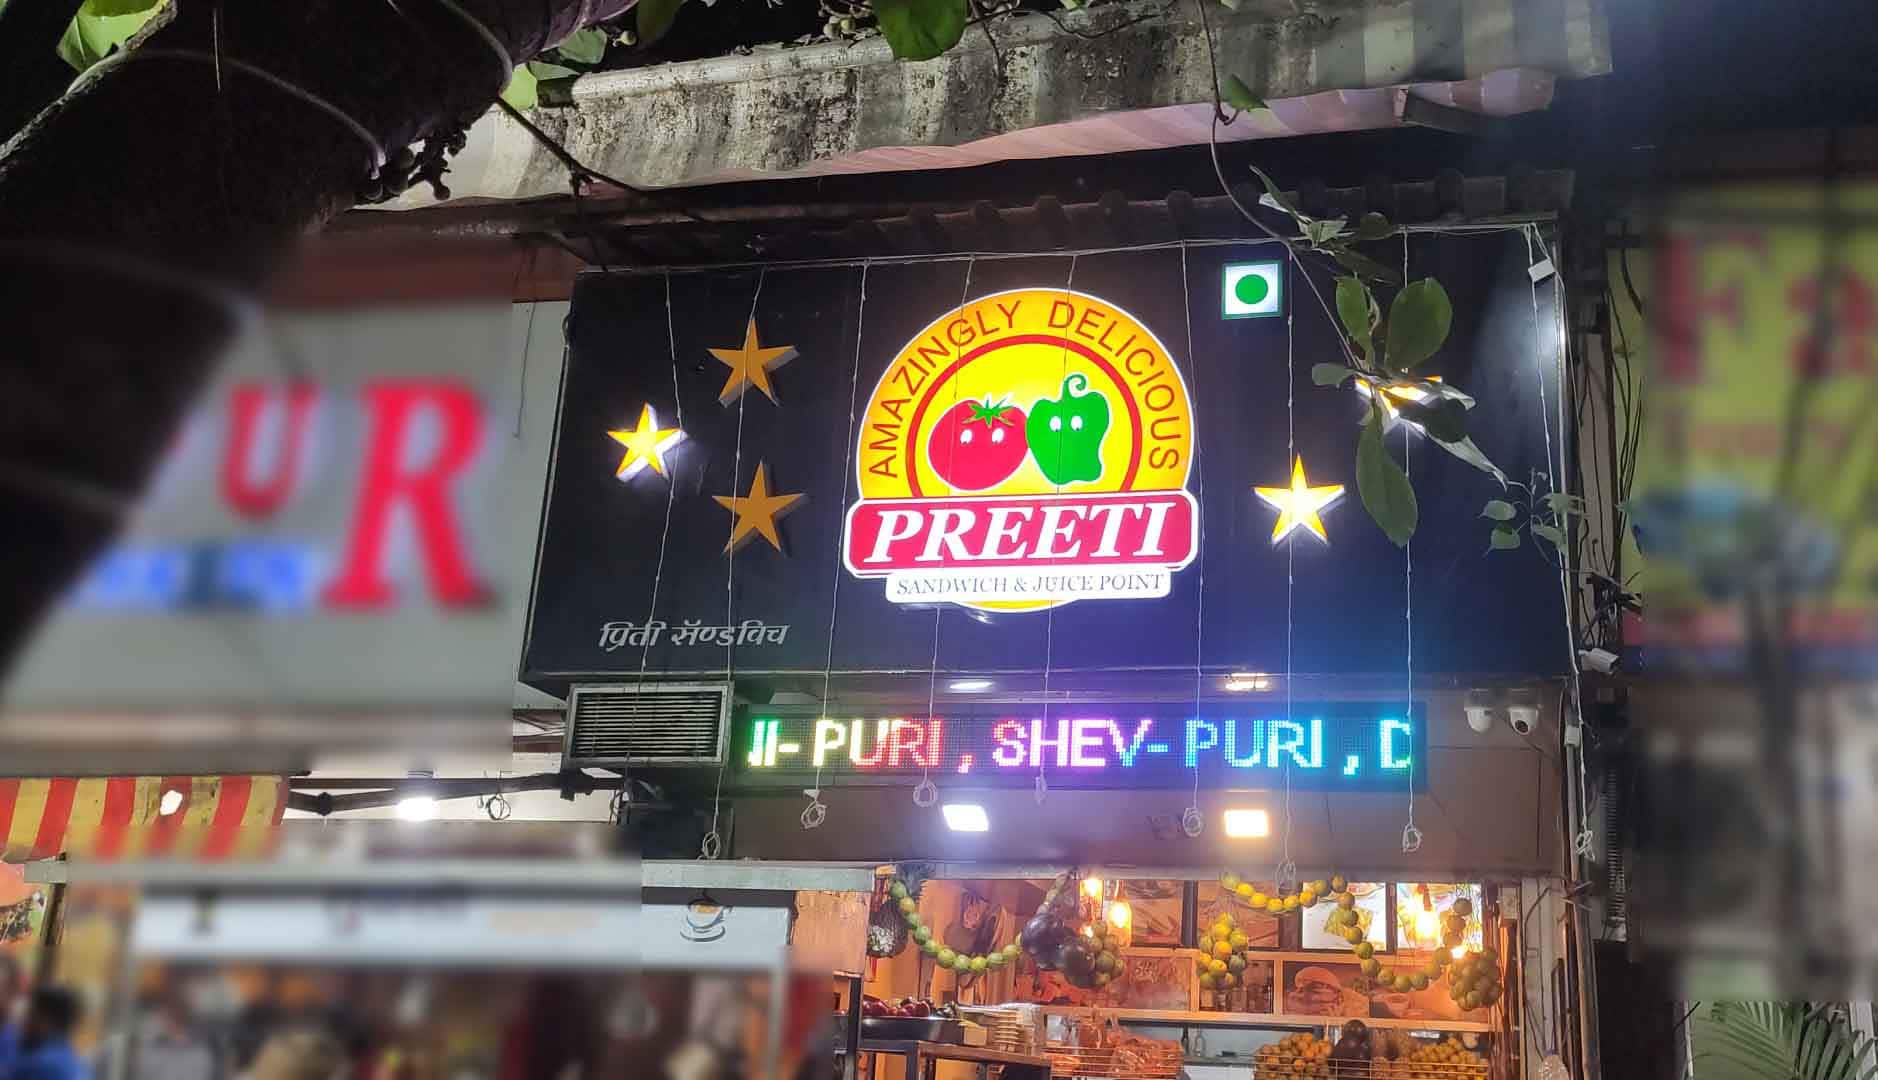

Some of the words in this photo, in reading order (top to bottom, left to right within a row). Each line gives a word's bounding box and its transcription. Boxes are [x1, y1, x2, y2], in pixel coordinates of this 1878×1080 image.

[868, 300, 1021, 479] AMAZINGLY
[1047, 300, 1180, 470] DELICIOUS
[863, 502, 1177, 564] PREETI
[897, 576, 1007, 595] SANDWICH
[1013, 577, 1028, 593] &
[1032, 574, 1094, 593] JUICE
[1099, 573, 1166, 591] POINT
[599, 621, 667, 652] प्रिती
